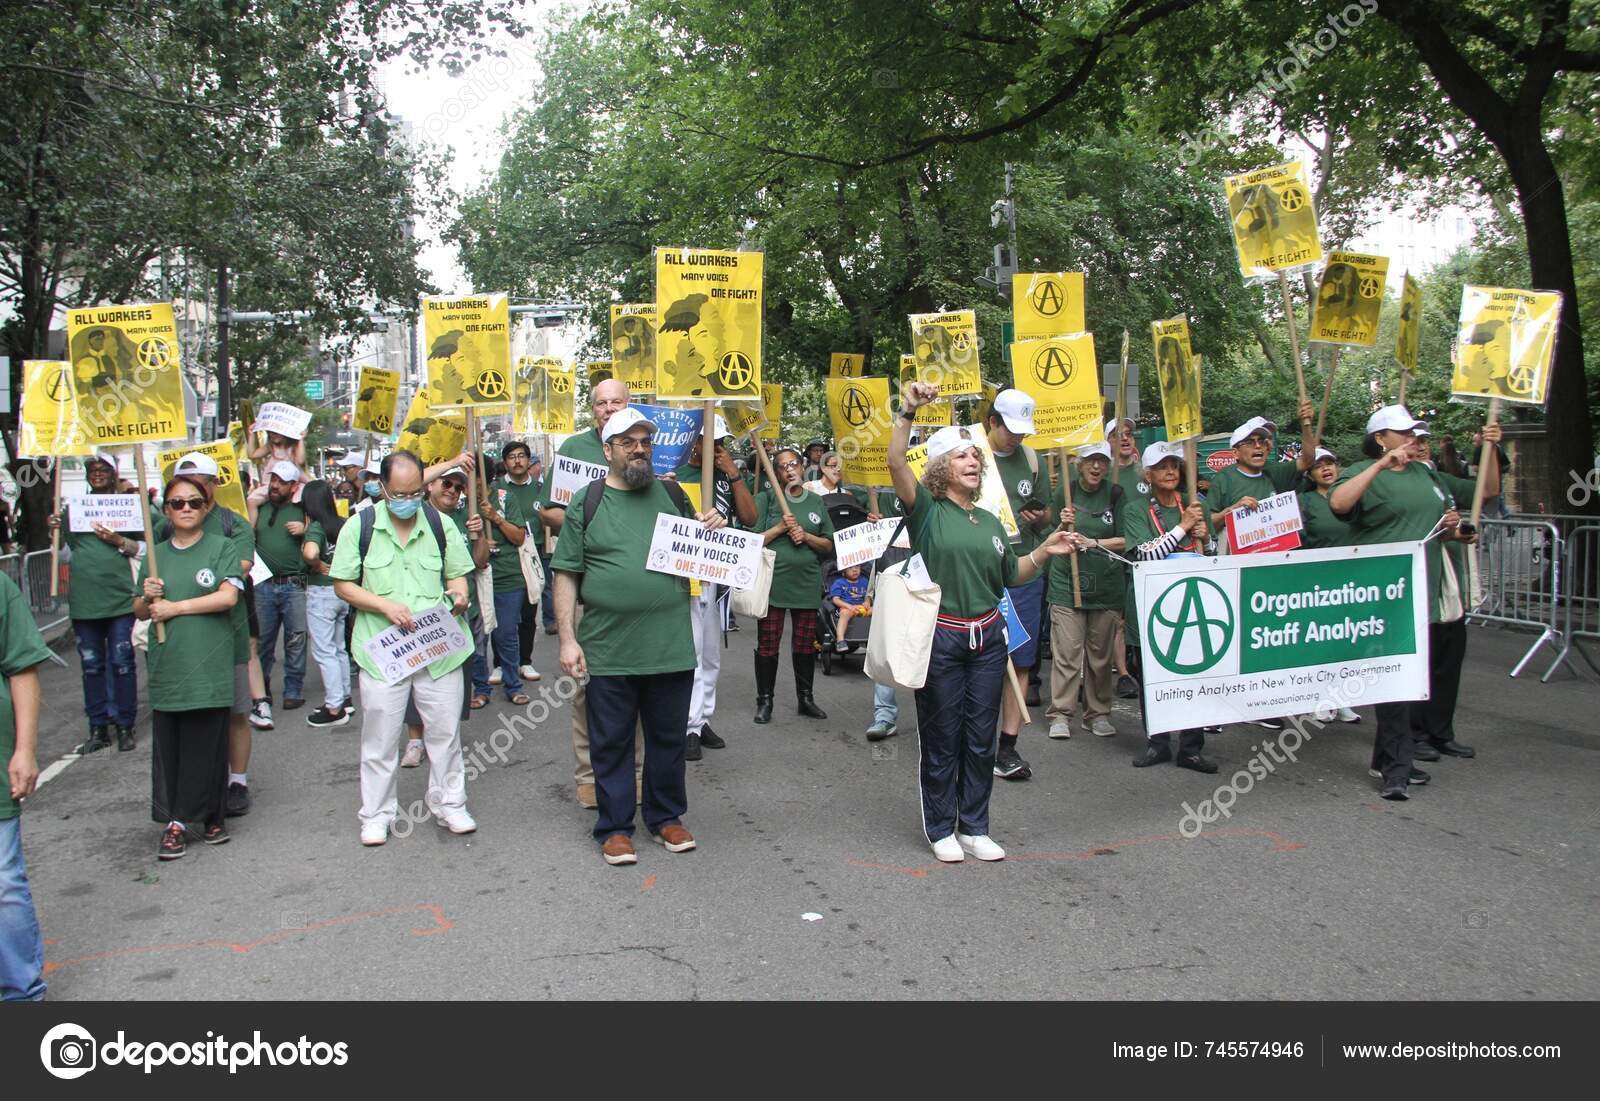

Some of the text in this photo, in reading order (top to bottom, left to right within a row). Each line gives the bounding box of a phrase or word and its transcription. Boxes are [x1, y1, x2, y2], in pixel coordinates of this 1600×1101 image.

[665, 254, 738, 267] ALL WORKERS
[1278, 250, 1311, 264] FIGHT!
[1344, 256, 1376, 266] WORKERS
[681, 273, 728, 282] MANY VOICES
[711, 288, 757, 299] ONE FIGHT!
[429, 300, 488, 311] ALL WORKERS
[75, 309, 152, 325] ALL WORKERS
[126, 325, 172, 335] MANY VOICES
[466, 324, 480, 332] ONE
[1320, 328, 1338, 338] ONE
[948, 382, 972, 391] FIGHT!
[1056, 403, 1097, 412] WORKERS
[98, 423, 124, 438] ONE
[128, 420, 173, 436] FIGHT!
[164, 454, 178, 462] ALL
[1208, 458, 1236, 466] STRAN
[559, 459, 606, 479] NEW YOR
[99, 498, 134, 506] WORKERS
[1236, 506, 1250, 520] NEW
[1276, 495, 1293, 507] CITY
[672, 524, 746, 548] ALL WORKERS
[838, 529, 856, 542] NEW
[860, 522, 884, 534] YORK
[1240, 518, 1300, 545] UNION TOWN
[672, 541, 738, 564] MANY VOICES
[841, 548, 874, 566] UNION
[676, 560, 730, 579] ONE FIGHT
[1250, 577, 1406, 617] Organization of
[380, 633, 399, 648] ALL
[1251, 616, 1384, 650] Staff Analysts
[392, 627, 446, 660] MANY VOICES
[406, 642, 450, 668] ONE FIGHT
[1155, 663, 1401, 702] Uniting Analysts in New York City Government
